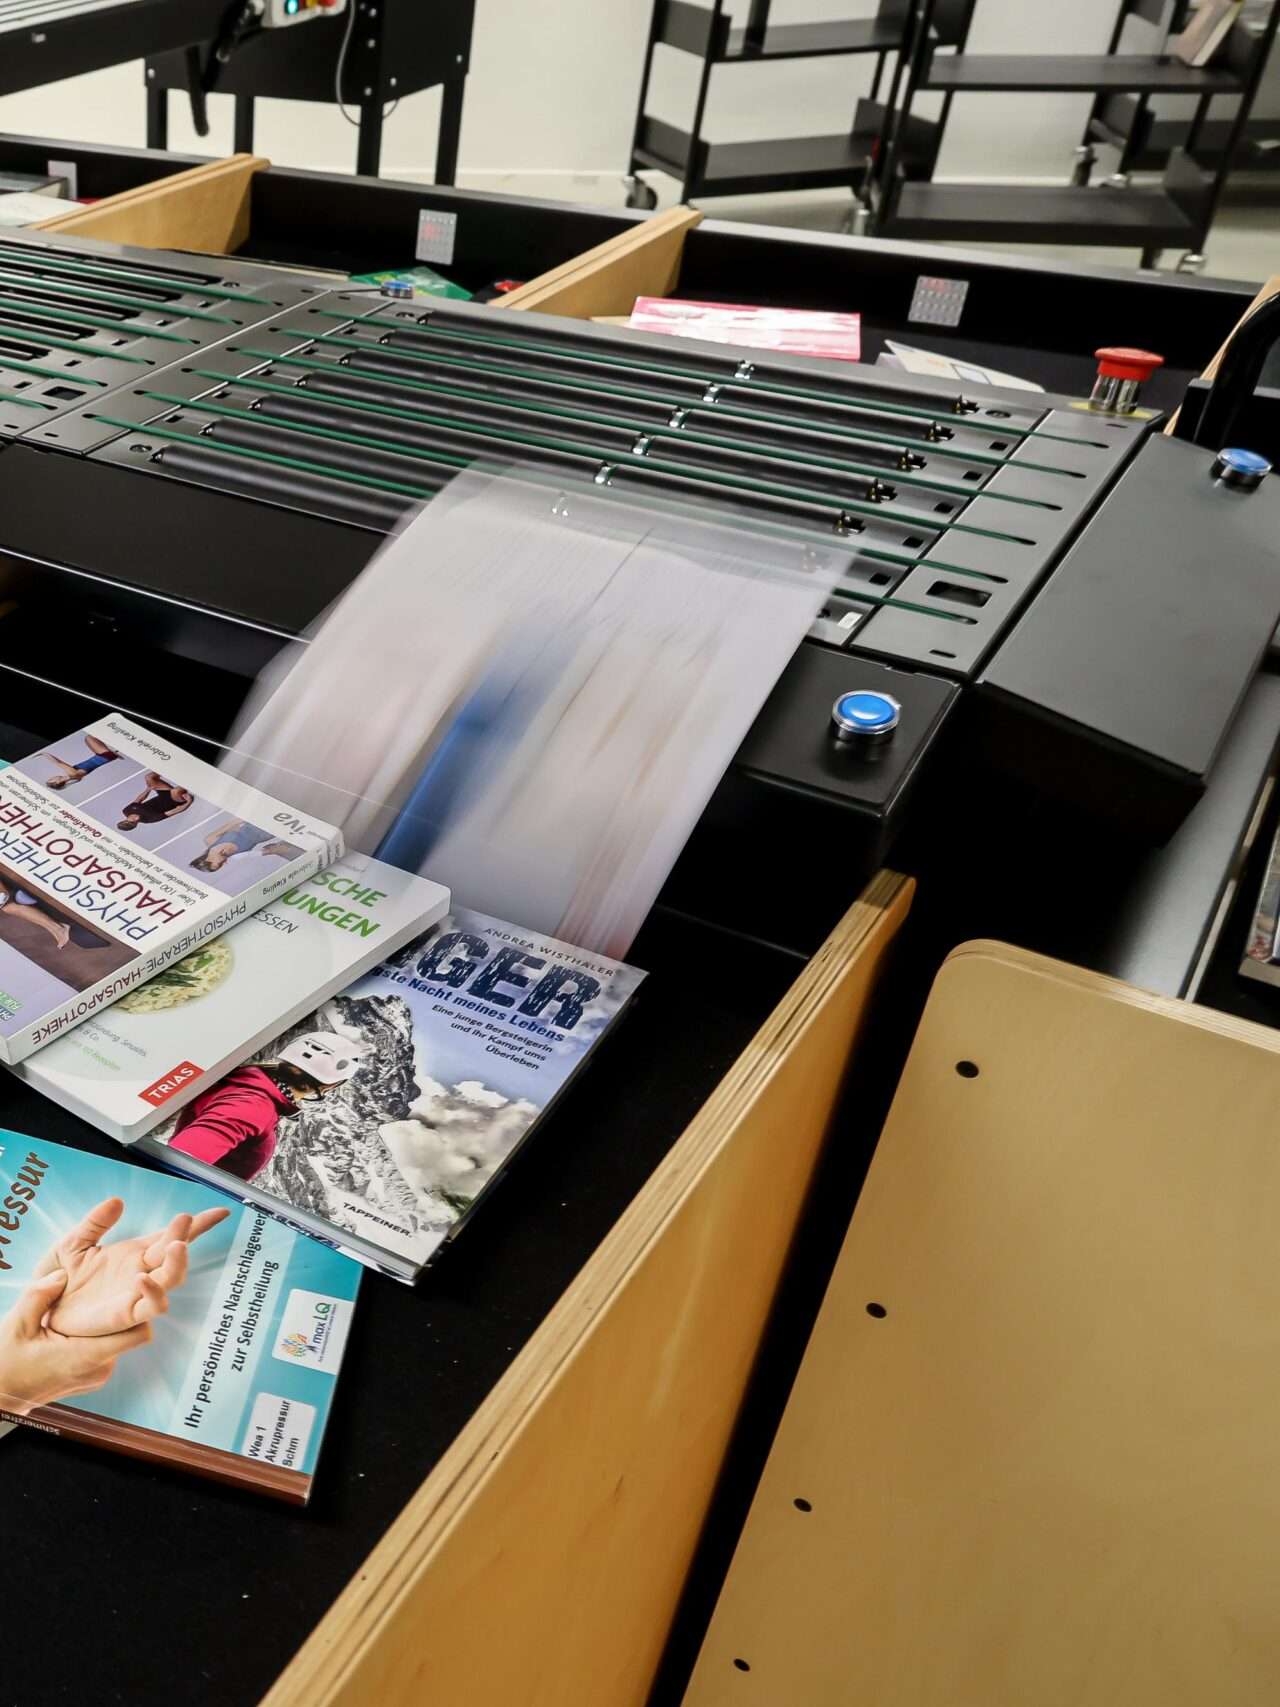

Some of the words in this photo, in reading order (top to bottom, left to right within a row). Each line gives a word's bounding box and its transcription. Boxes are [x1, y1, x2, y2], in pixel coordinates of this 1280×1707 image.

[106, 721, 137, 743] Kiesling
[135, 736, 172, 762] Gabriele
[59, 806, 103, 839] Quickfinder
[159, 883, 178, 897] 100
[483, 926, 537, 952] ANDREA
[538, 944, 617, 979] WISTHALER
[31, 901, 248, 1046] PHYSIOTHERAPIE-HAUSAPOTHEKE
[406, 976, 453, 1008] Nacht
[452, 995, 507, 1022] meines
[508, 1012, 568, 1044] Lebens
[430, 1003, 455, 1019] Eine
[453, 1010, 484, 1029] junge
[484, 1022, 555, 1055] Bergsteigerin
[449, 1021, 471, 1036] und
[471, 1027, 488, 1041] ihr
[487, 1034, 524, 1056] Kampf
[523, 1047, 547, 1063] ums
[484, 1041, 541, 1071] Überleben
[147, 1066, 196, 1100] TRIAS
[183, 1403, 205, 1430] Ihr
[195, 1311, 235, 1405] persönliches
[222, 1210, 270, 1313] Nachschlagewer
[235, 1259, 281, 1348] Selbstheilung
[230, 1348, 248, 1373] zur
